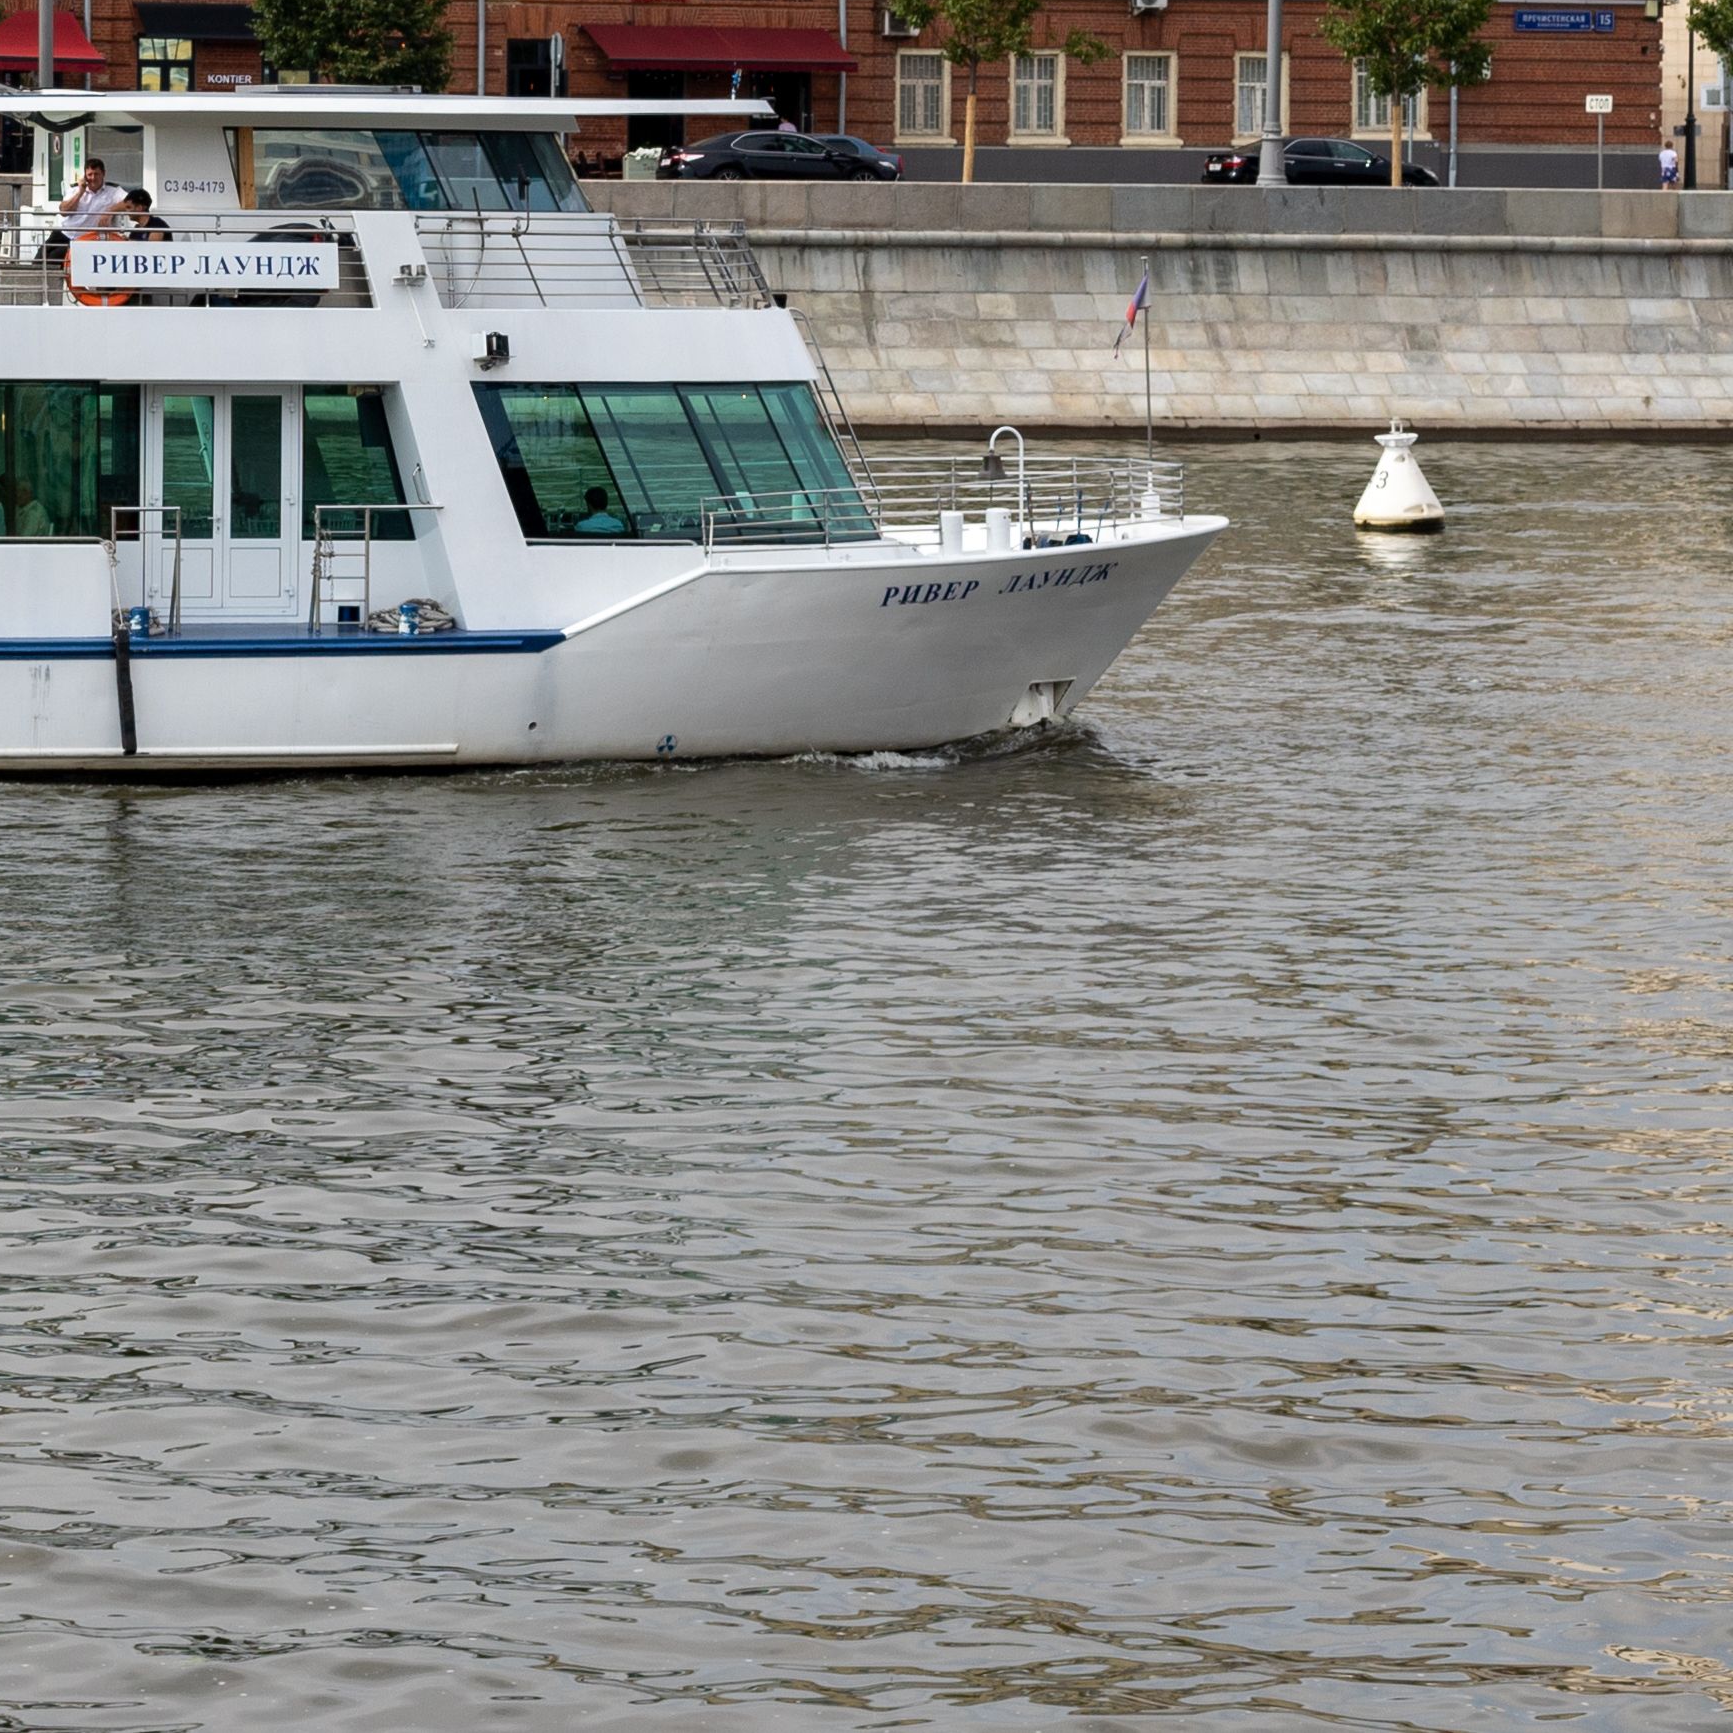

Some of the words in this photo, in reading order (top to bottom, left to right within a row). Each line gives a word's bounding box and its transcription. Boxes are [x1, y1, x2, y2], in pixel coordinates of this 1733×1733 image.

[1599, 14, 1611, 26] 15
[206, 73, 253, 84] KONTIER
[1589, 97, 1610, 110] СТОП
[181, 180, 225, 194] 49-4179
[91, 254, 186, 275] РИВЕР
[193, 255, 321, 279] ЛАУНДЖ
[880, 579, 981, 607] РИВЕР
[997, 561, 1119, 595] ЛАУНДЖ
